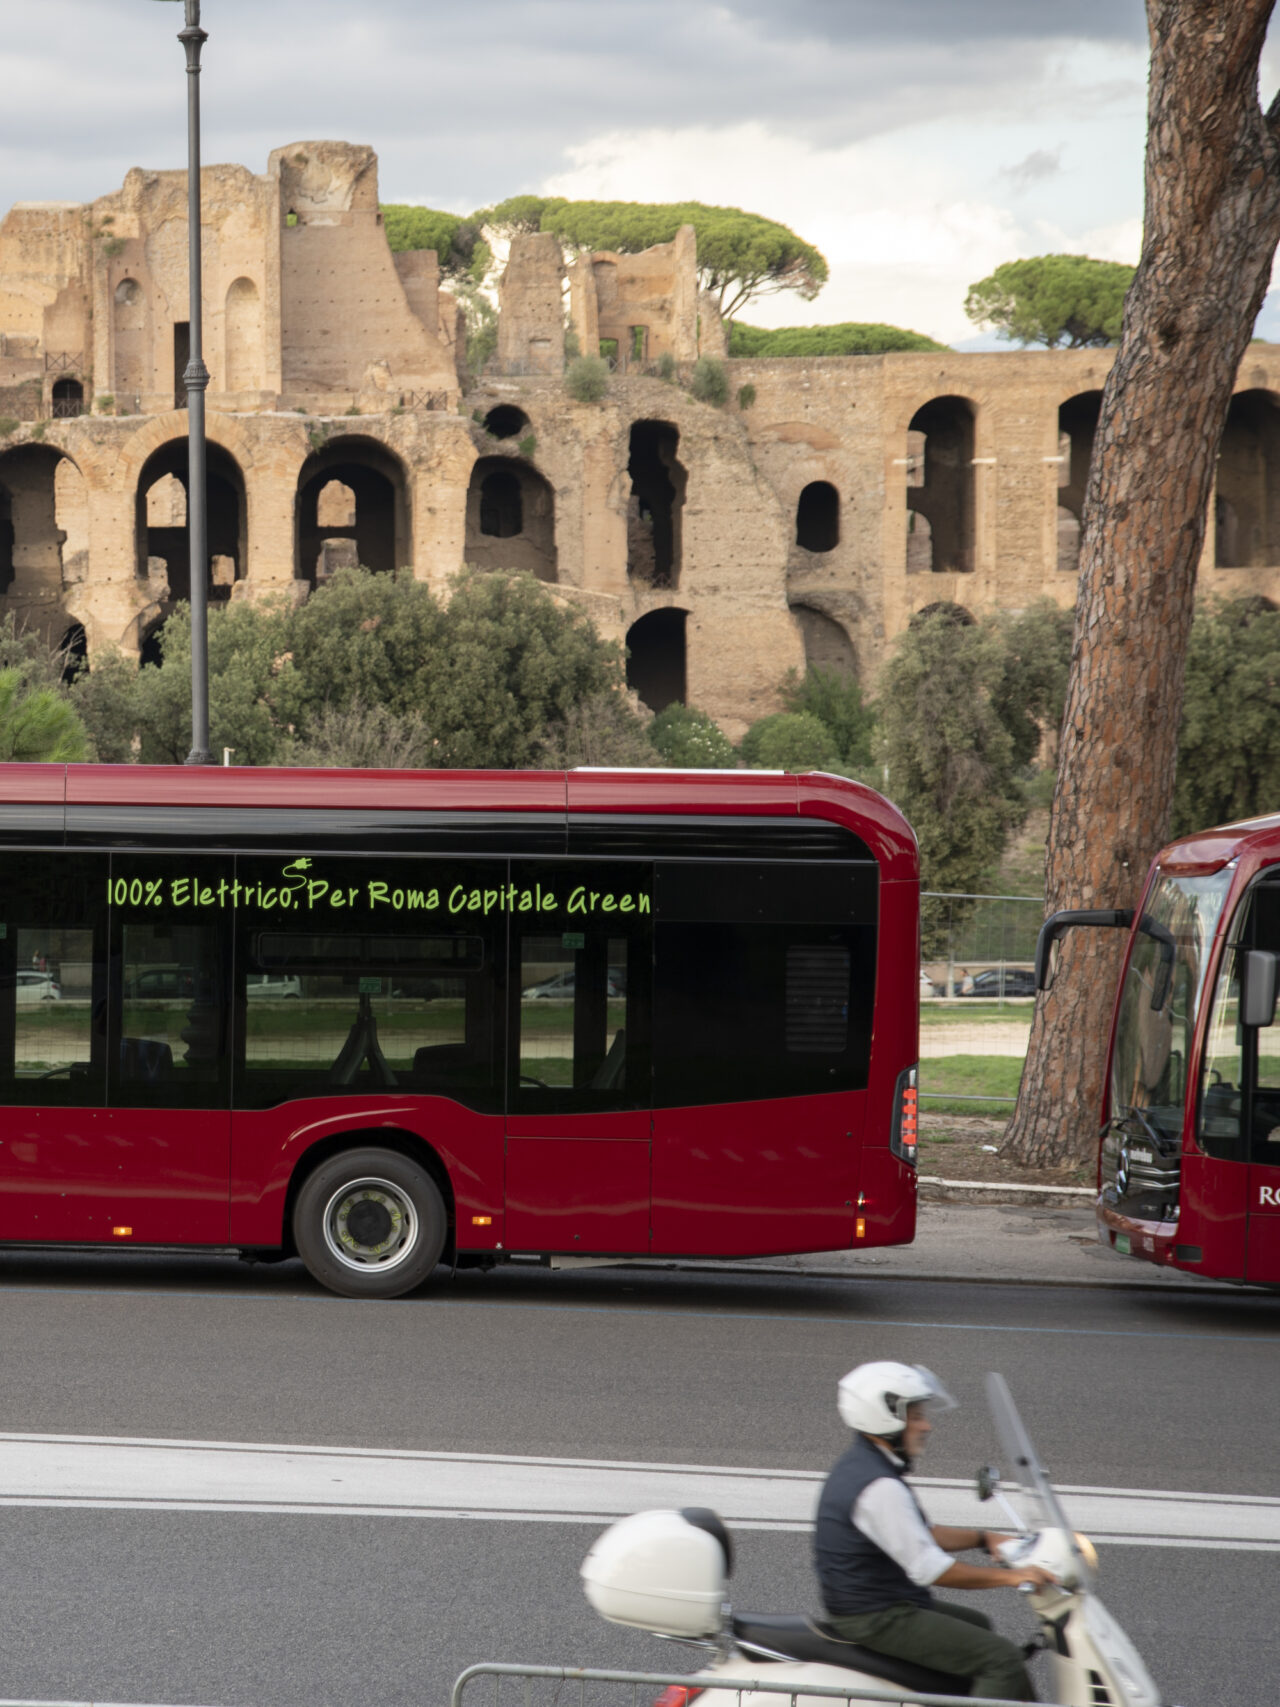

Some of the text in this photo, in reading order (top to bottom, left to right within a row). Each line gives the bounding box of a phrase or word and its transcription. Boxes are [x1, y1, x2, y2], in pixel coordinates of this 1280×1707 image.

[107, 878, 162, 905] 100%
[307, 879, 360, 908] Per
[368, 881, 439, 909] Roma
[449, 883, 558, 916] Capitale
[567, 887, 651, 914] Green
